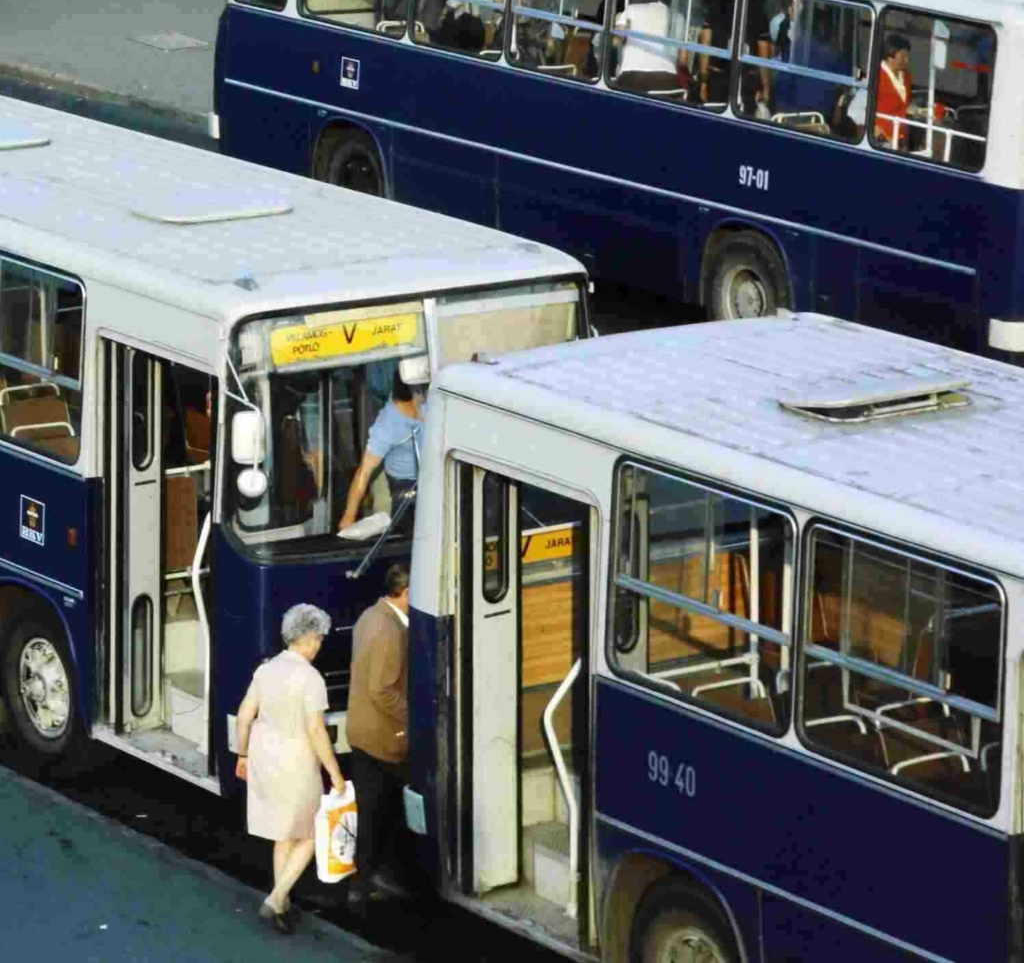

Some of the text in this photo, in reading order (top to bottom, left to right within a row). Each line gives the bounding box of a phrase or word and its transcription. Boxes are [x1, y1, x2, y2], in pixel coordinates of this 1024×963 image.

[739, 165, 769, 191] 97-01
[341, 323, 358, 344] V
[22, 525, 43, 542] BKV
